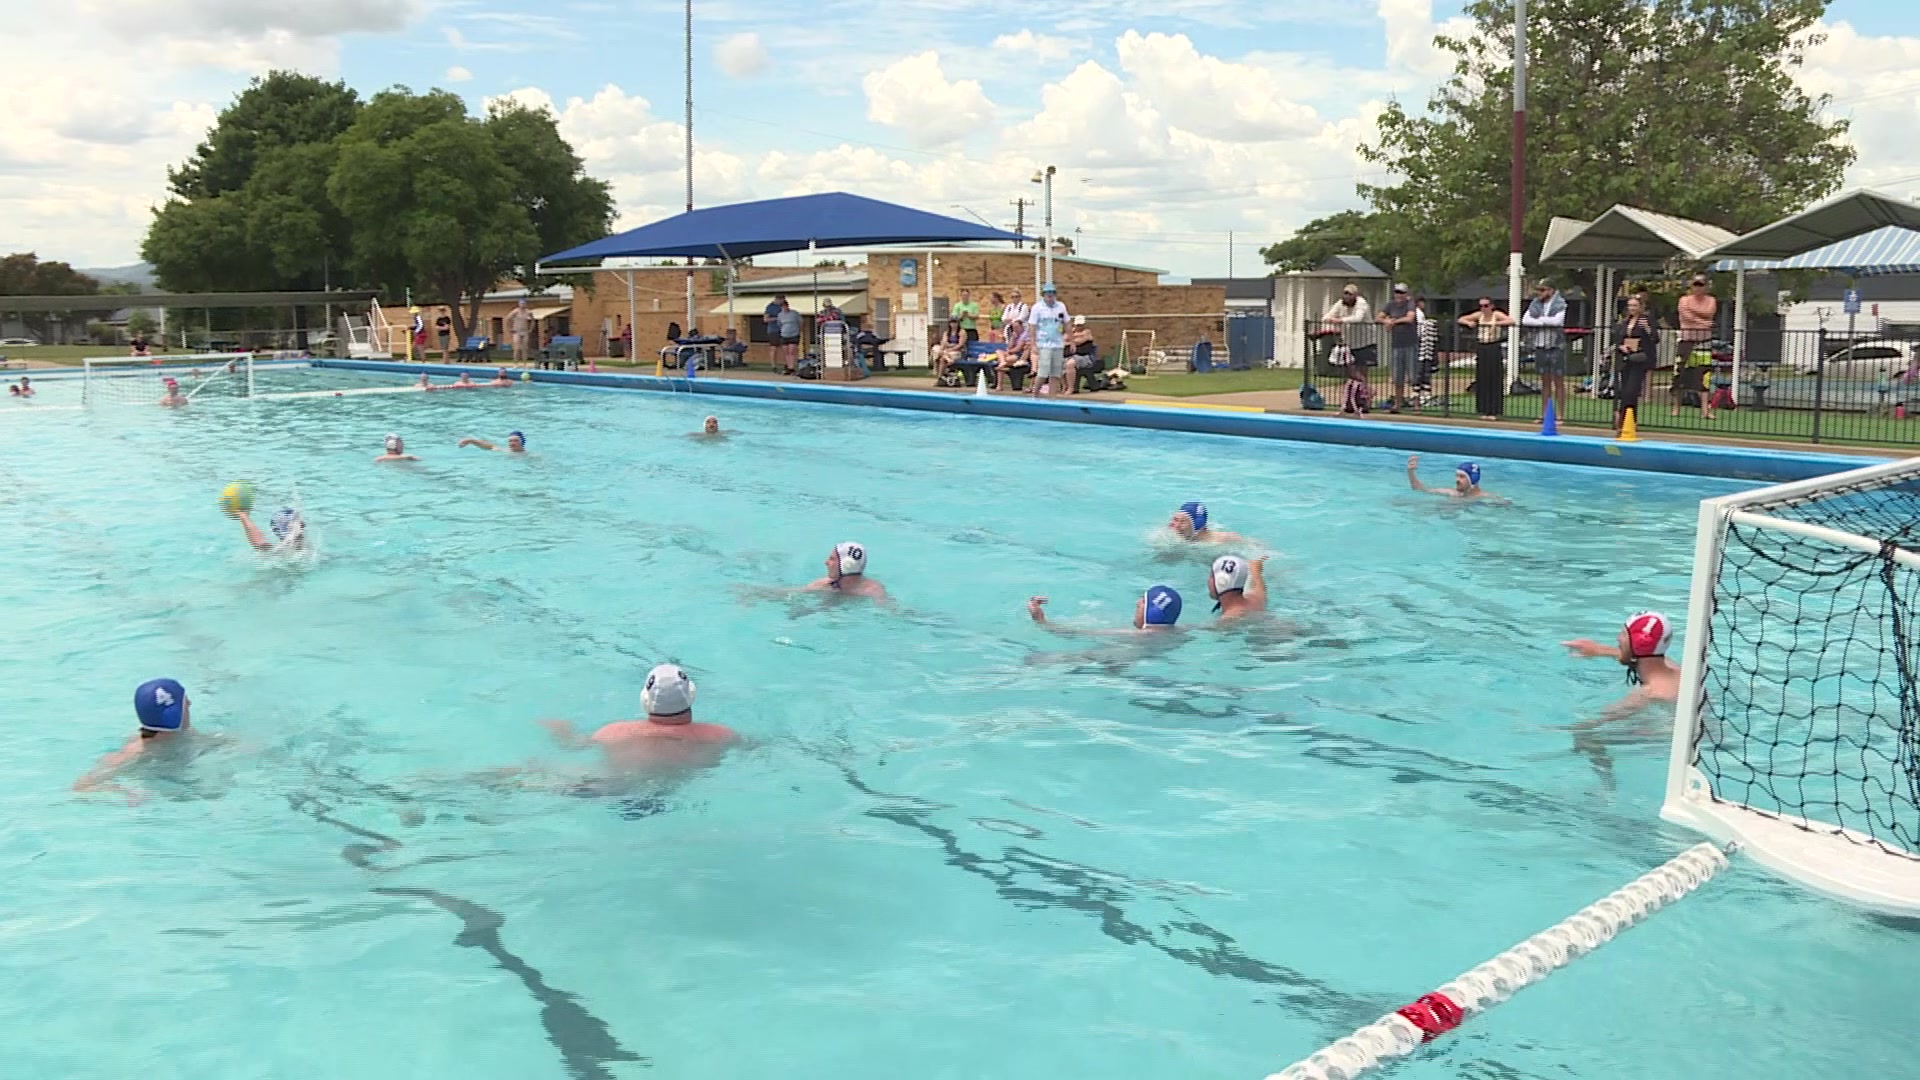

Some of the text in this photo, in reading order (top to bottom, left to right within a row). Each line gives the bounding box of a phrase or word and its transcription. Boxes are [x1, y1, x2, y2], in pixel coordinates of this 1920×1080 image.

[847, 546, 863, 560] 10
[1221, 560, 1236, 574] 13
[1152, 591, 1172, 610] 11
[1641, 617, 1658, 635] 1
[155, 686, 175, 706] 4
